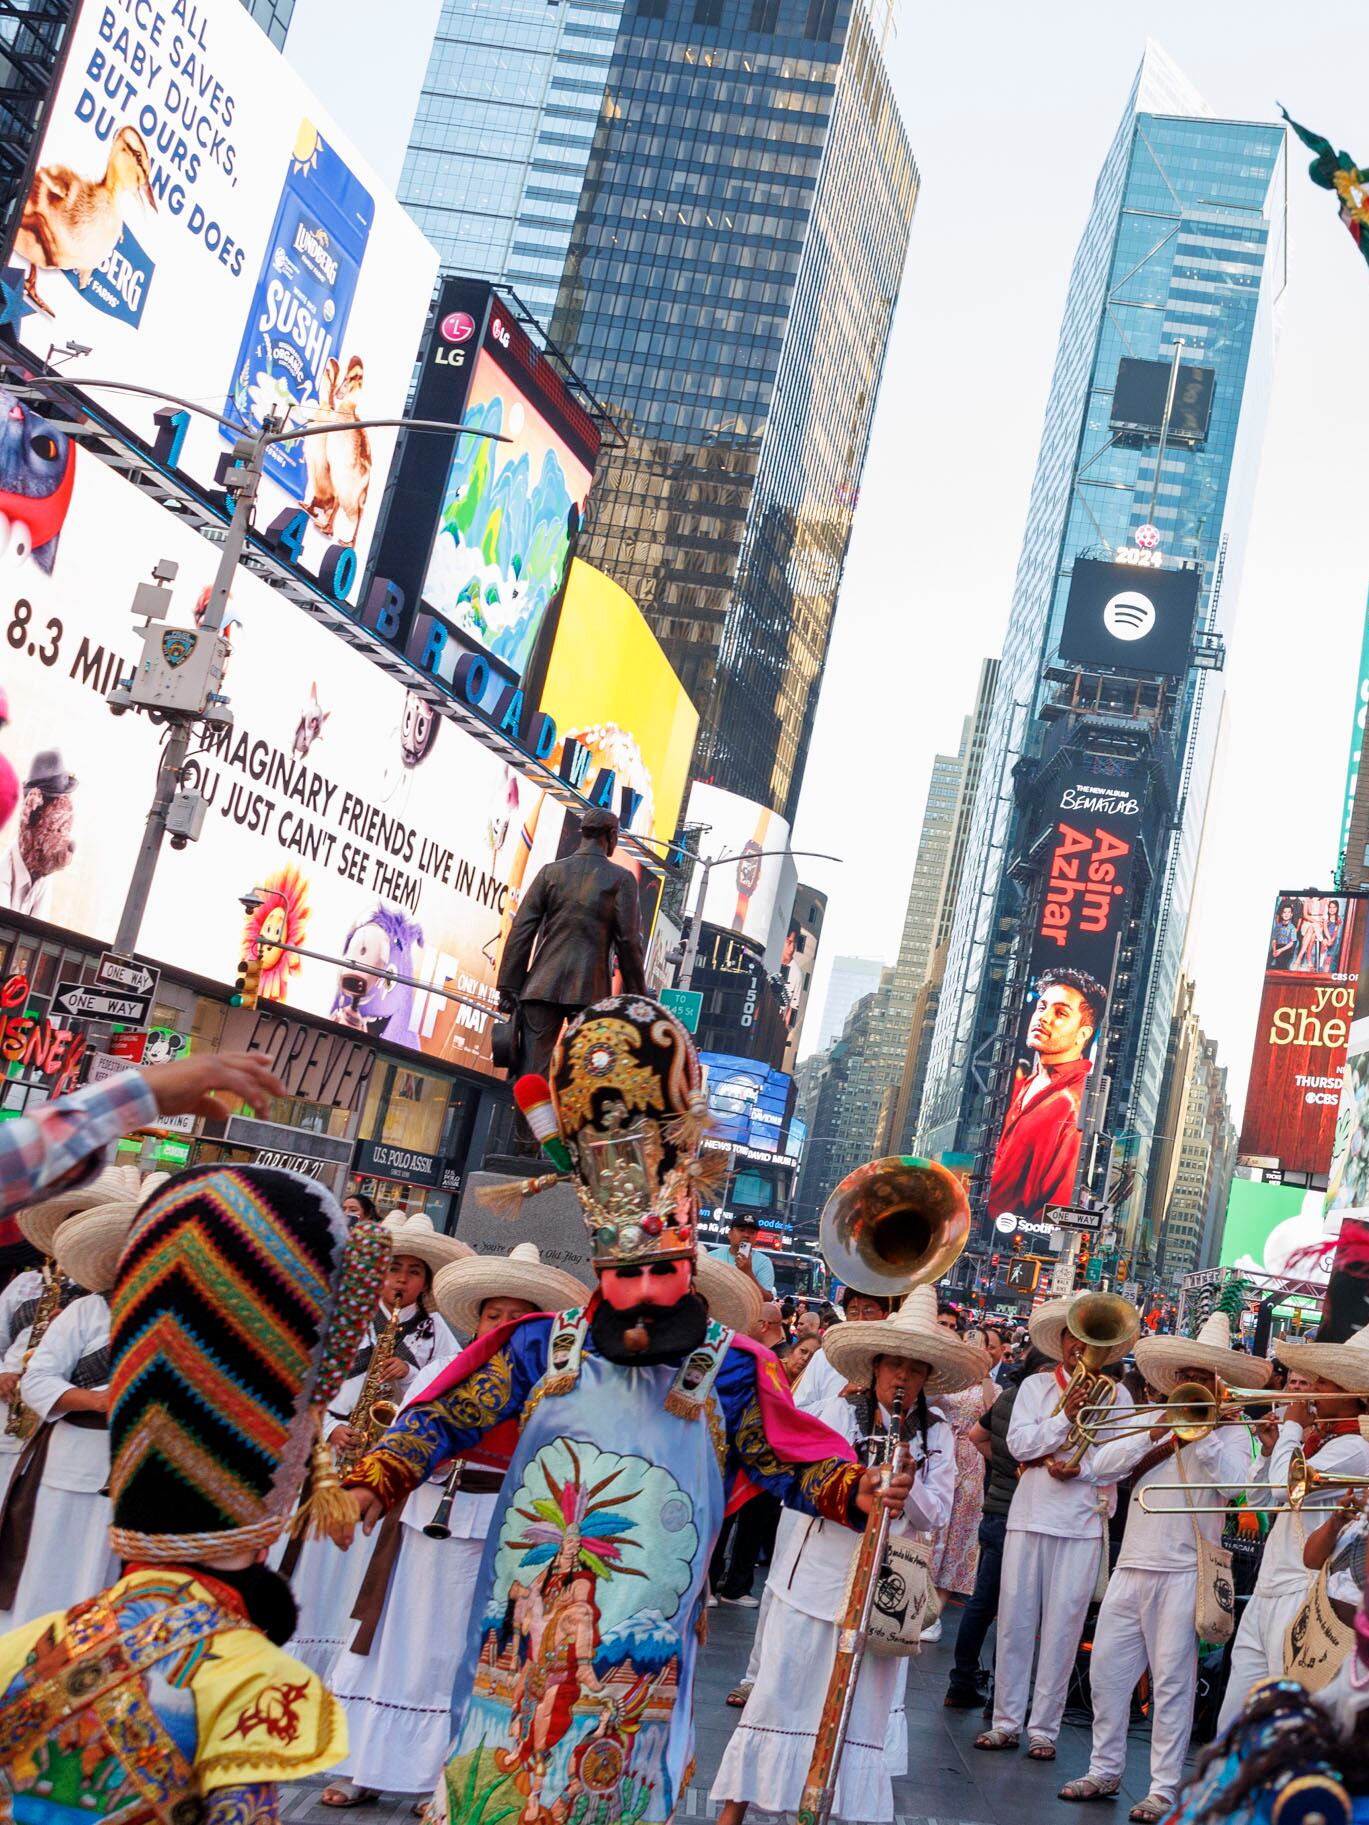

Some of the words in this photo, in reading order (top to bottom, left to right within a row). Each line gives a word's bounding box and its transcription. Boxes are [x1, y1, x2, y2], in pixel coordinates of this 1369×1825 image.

[171, 0, 207, 52] ALL
[98, 5, 162, 89] BABY
[164, 79, 237, 187] DUCKS,
[169, 35, 235, 127] SAVES
[86, 47, 138, 112] BUT
[139, 104, 201, 184] OURS
[187, 203, 244, 277] DOES
[293, 222, 338, 285] LUNDBERG
[259, 279, 333, 391] SUSHI
[499, 327, 510, 349] LG
[272, 347, 304, 382] ORGANIC
[435, 347, 465, 366] LG
[1116, 547, 1163, 568] 2024
[7, 598, 63, 667] 8.3
[362, 575, 644, 831] BROADWAY
[199, 721, 338, 817] IMAGINARY
[338, 791, 417, 863] FRIENDS
[418, 837, 455, 884] LIVE
[454, 859, 476, 897] IN
[476, 872, 509, 916] NYC
[181, 759, 221, 807] OU
[221, 782, 276, 836] JUST
[278, 811, 338, 867] CAN'T
[337, 842, 370, 886] SEE
[372, 859, 422, 916] THEM)
[1041, 822, 1094, 947] Azhar
[1079, 827, 1130, 933] Asim
[106, 965, 124, 981] ONE
[131, 972, 149, 989] WAY
[1331, 973, 1348, 981] CBS
[68, 994, 96, 1010] ONE
[107, 998, 137, 1015] WAY
[675, 995, 687, 1004] TO
[740, 977, 757, 1028] 1500
[456, 1003, 489, 1034] MAY
[1269, 1007, 1349, 1048] She
[247, 1010, 377, 1112] FOREVER
[1316, 1094, 1339, 1106] CBS
[255, 1151, 308, 1176] FOREVER
[373, 1146, 387, 1165] U.S.
[387, 1151, 409, 1169] POLO
[409, 1154, 432, 1174] ASSN.
[704, 1140, 732, 1152] NEWS
[443, 1174, 461, 1182] POLO
[1052, 1210, 1069, 1221] ONE
[1077, 1214, 1097, 1225] WAY
[544, 1248, 562, 1260] Old
[563, 1250, 584, 1264] Flag
[1123, 1291, 1136, 1301] 25
